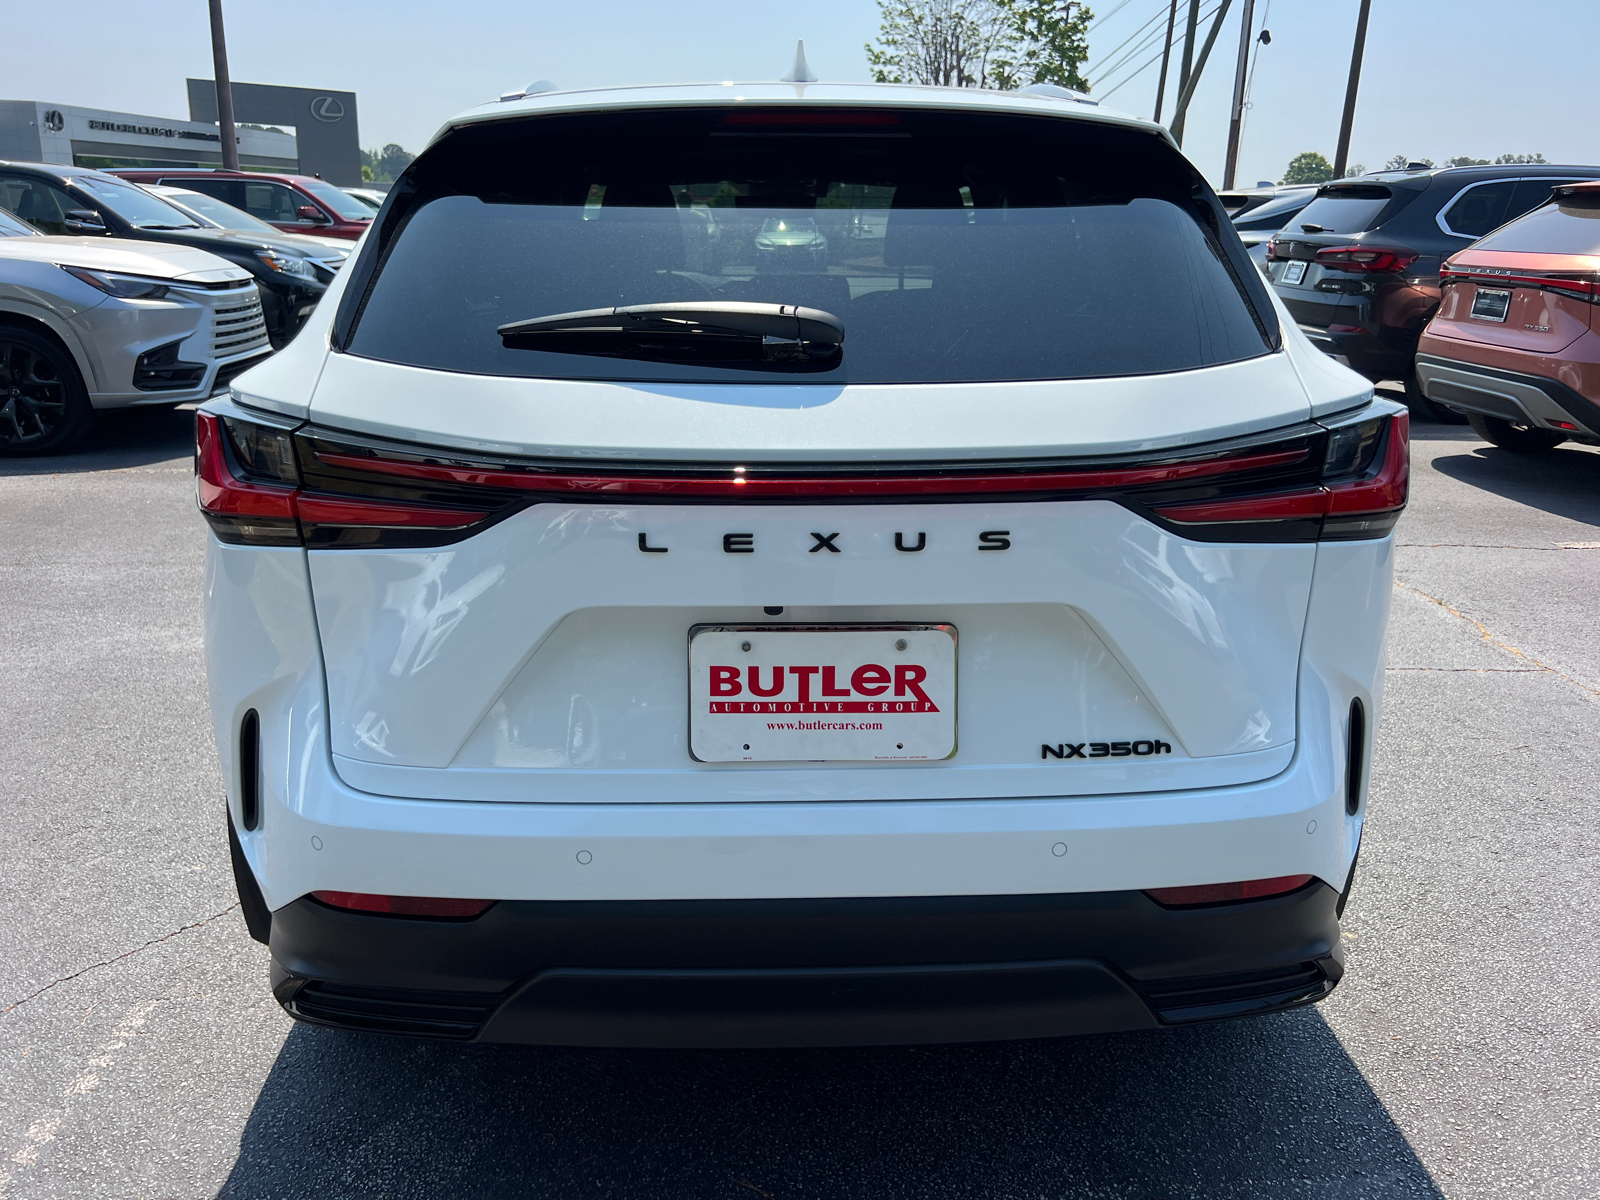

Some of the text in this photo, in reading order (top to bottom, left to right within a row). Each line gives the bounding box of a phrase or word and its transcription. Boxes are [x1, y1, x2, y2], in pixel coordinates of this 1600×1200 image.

[1467, 267, 1511, 276] LEXUS
[637, 530, 1012, 554] LEXUS
[710, 701, 932, 713] AUTOMOTIVE GROUP
[766, 720, 883, 731] www.butlercars.com
[1041, 739, 1172, 760] NX350h
